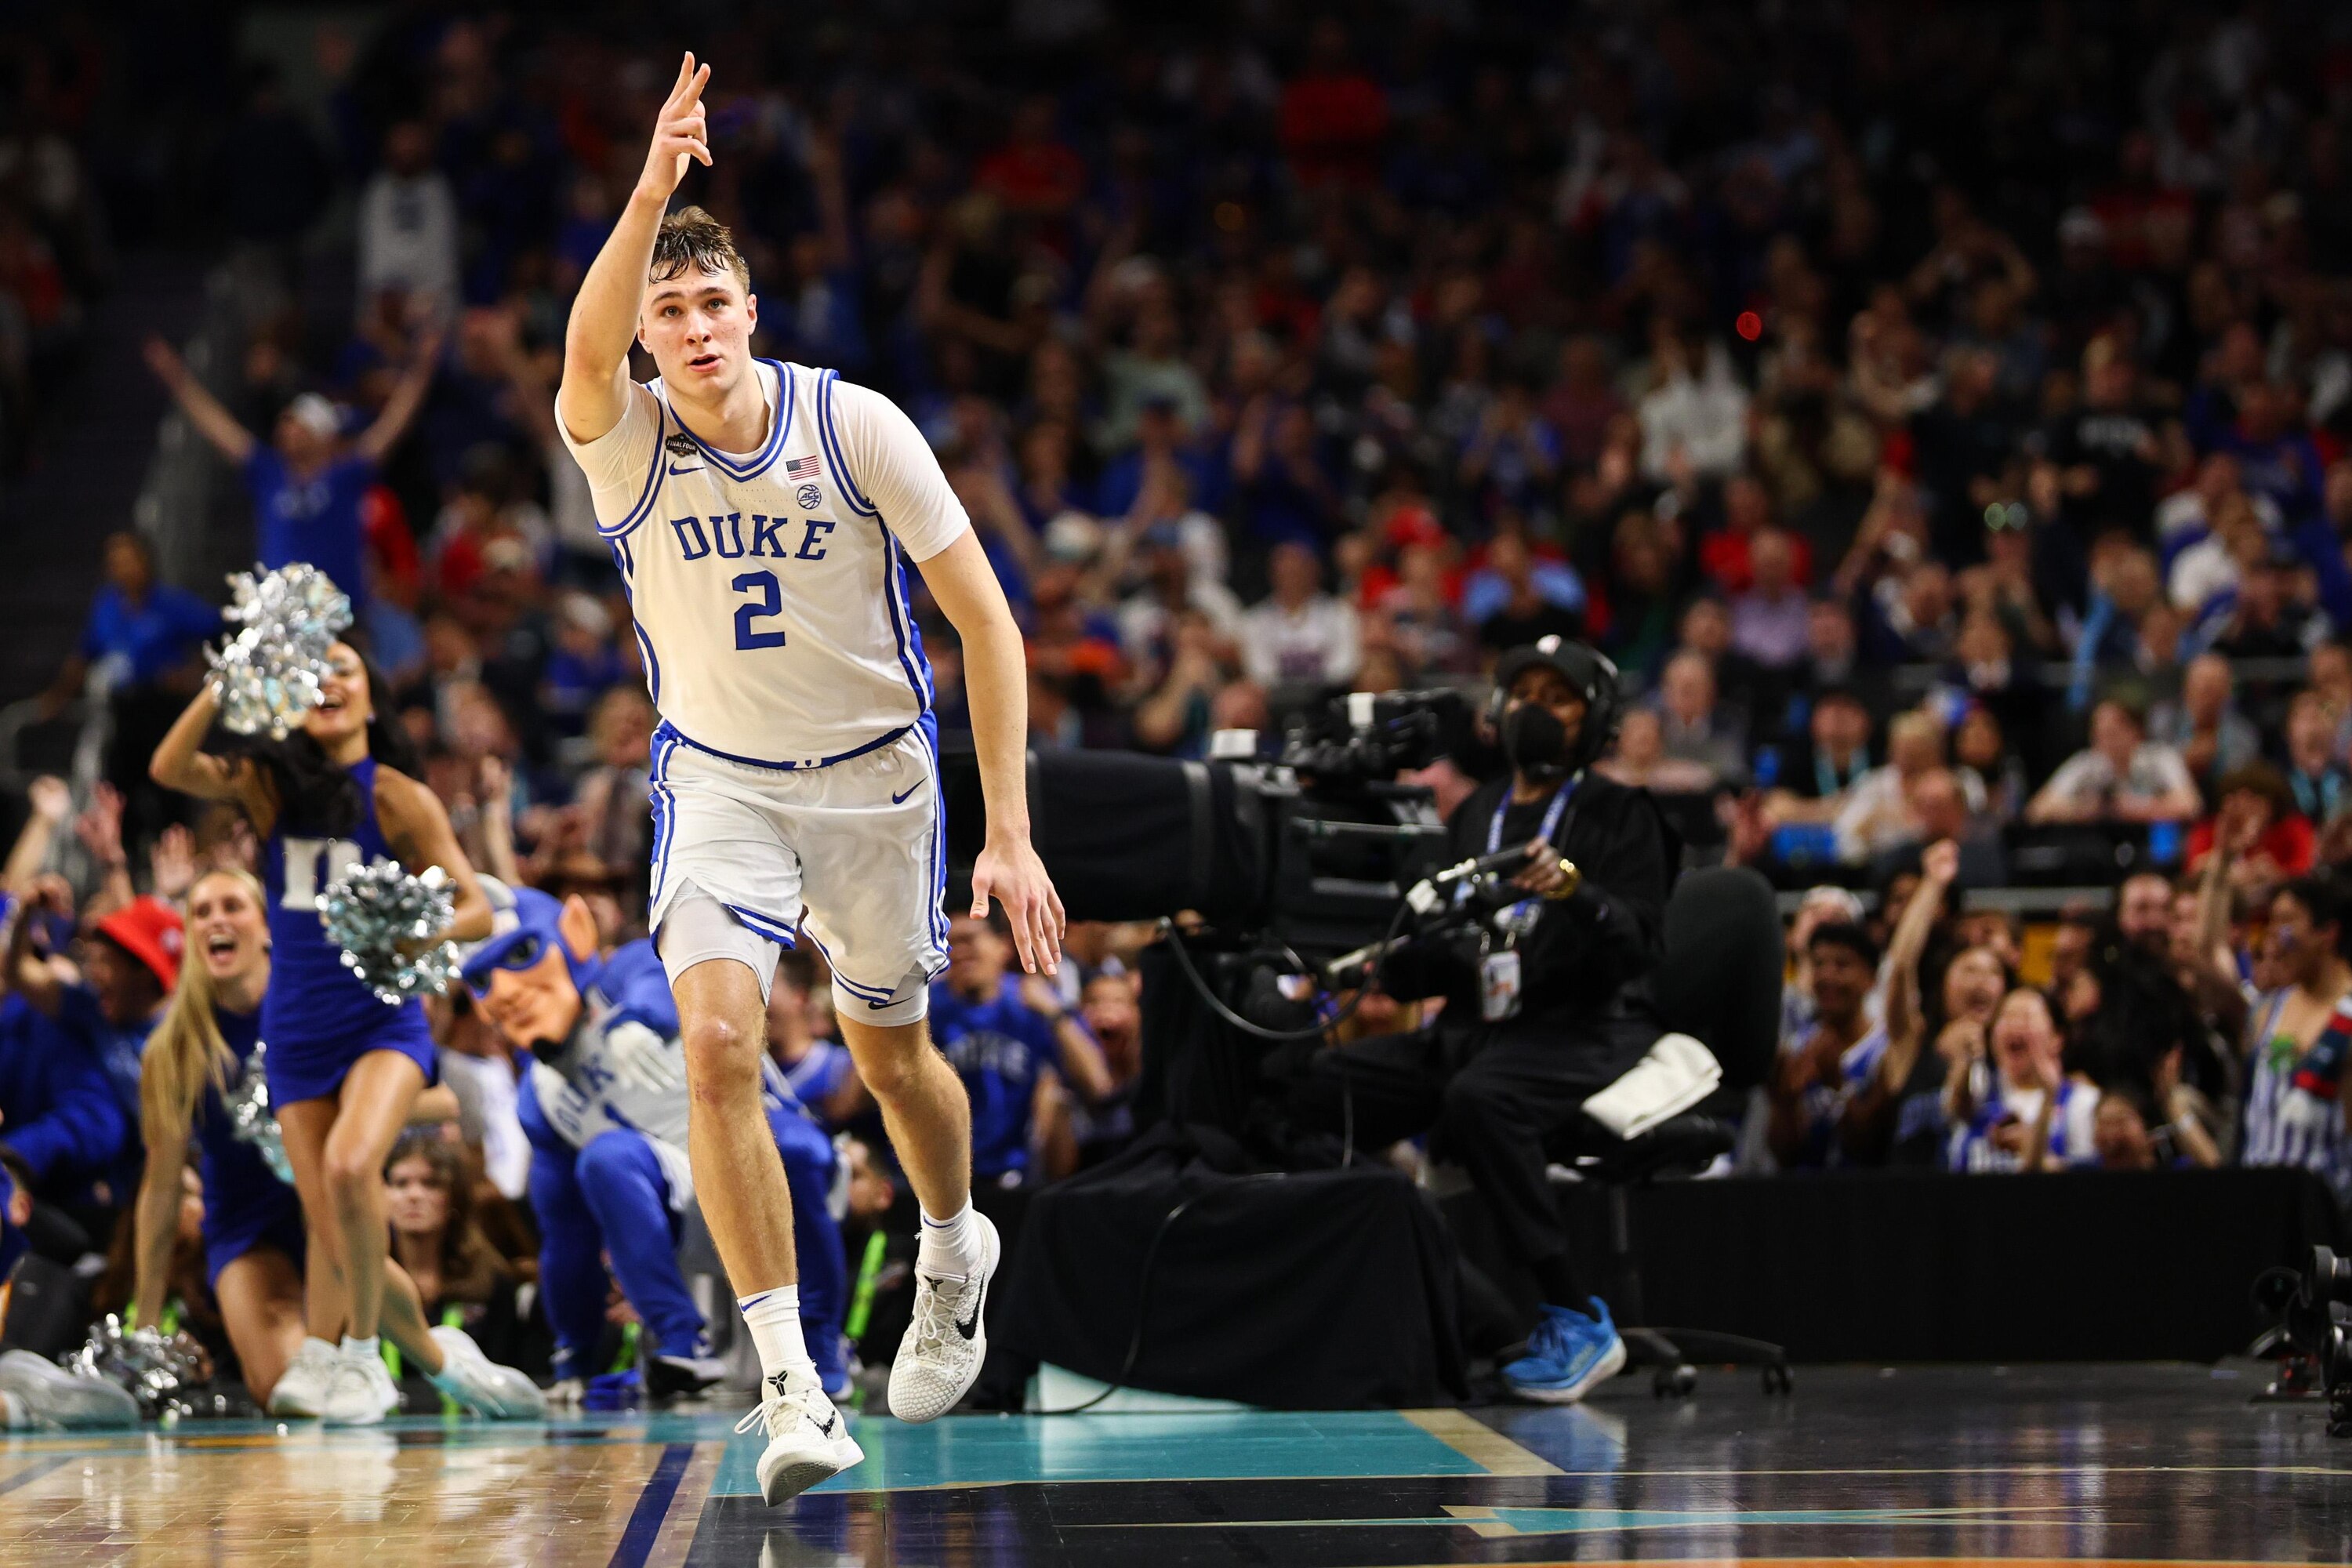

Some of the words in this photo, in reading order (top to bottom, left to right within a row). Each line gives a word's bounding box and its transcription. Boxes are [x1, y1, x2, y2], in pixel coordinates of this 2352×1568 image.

[682, 442, 696, 451] FOUR
[800, 491, 819, 499] ACC
[670, 513, 836, 561] DUKE
[731, 570, 786, 651] 2
[556, 1053, 615, 1134] DUK
